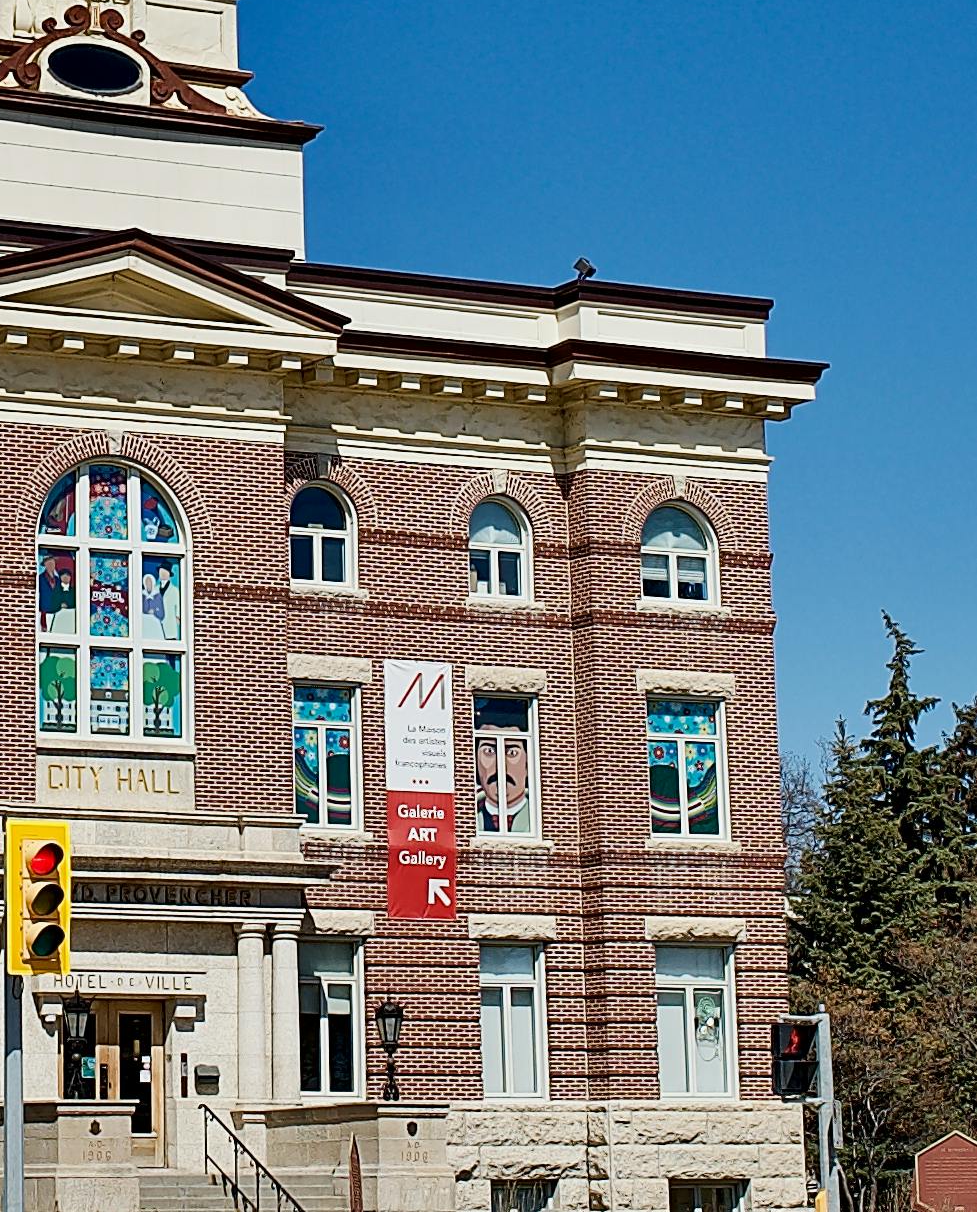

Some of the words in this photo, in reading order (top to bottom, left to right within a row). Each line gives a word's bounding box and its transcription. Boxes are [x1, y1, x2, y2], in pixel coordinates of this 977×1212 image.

[48, 764, 103, 792] CITY
[117, 767, 180, 794] HALL
[396, 804, 445, 819] Galerie
[407, 827, 438, 842] ART
[398, 850, 447, 869] Gallery
[105, 884, 252, 906] PROVENCHER
[145, 975, 192, 991] VILLE
